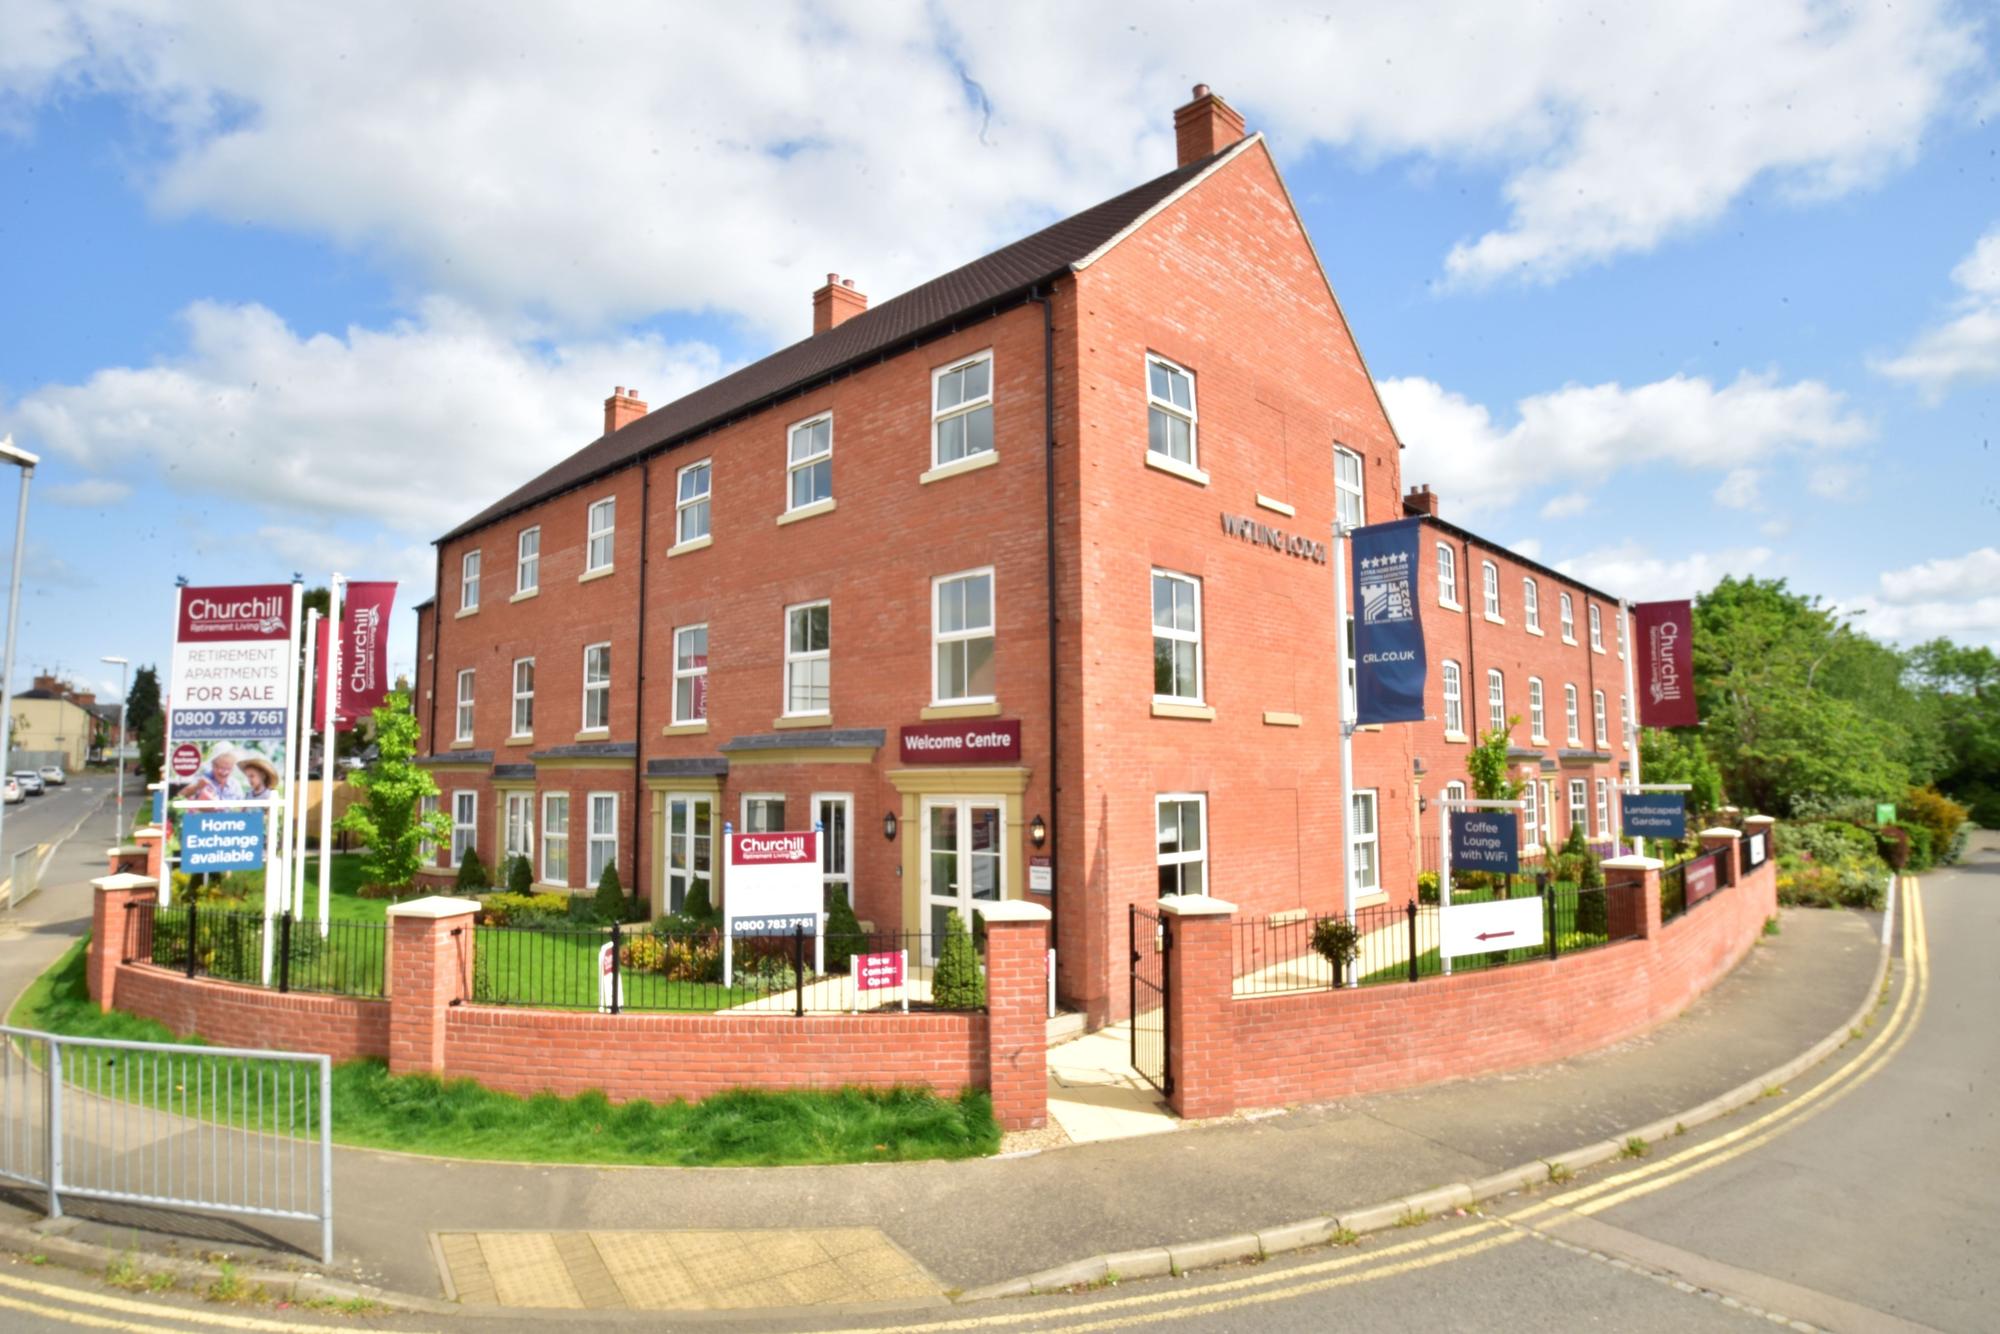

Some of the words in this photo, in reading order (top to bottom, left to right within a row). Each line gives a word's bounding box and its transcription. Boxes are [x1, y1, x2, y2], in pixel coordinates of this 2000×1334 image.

[1388, 581, 1403, 619] HBF
[1400, 580, 1413, 617] 2023
[188, 596, 283, 619] Churchill
[190, 623, 233, 632] Retirement
[235, 622, 259, 632] Living
[188, 648, 277, 662] RETIREMENT
[351, 608, 369, 692] Churchill
[1363, 650, 1415, 663] CRL.CO.UK
[1660, 621, 1681, 700] Churchill
[184, 666, 279, 680] APARTMENTS
[186, 686, 223, 702] FOR
[229, 685, 275, 701] SALE
[174, 711, 215, 726] 0800
[219, 711, 246, 725] 783
[251, 710, 284, 724] 7661
[904, 734, 963, 750] Welcome
[965, 732, 1011, 748] Centre
[1624, 806, 1682, 816] Landscaped
[201, 819, 246, 832] Home
[1464, 821, 1499, 834] Coffee
[1631, 817, 1672, 827] Gardens
[186, 834, 259, 850] Exchange
[740, 837, 804, 851] Churchill
[1463, 835, 1501, 849] Lounge
[190, 850, 254, 865] available
[1460, 850, 1482, 860] with
[1483, 850, 1508, 862] WiFi
[734, 920, 765, 931] 0800
[767, 919, 787, 929] 783
[867, 957, 889, 966] Show
[867, 977, 889, 986] Open
